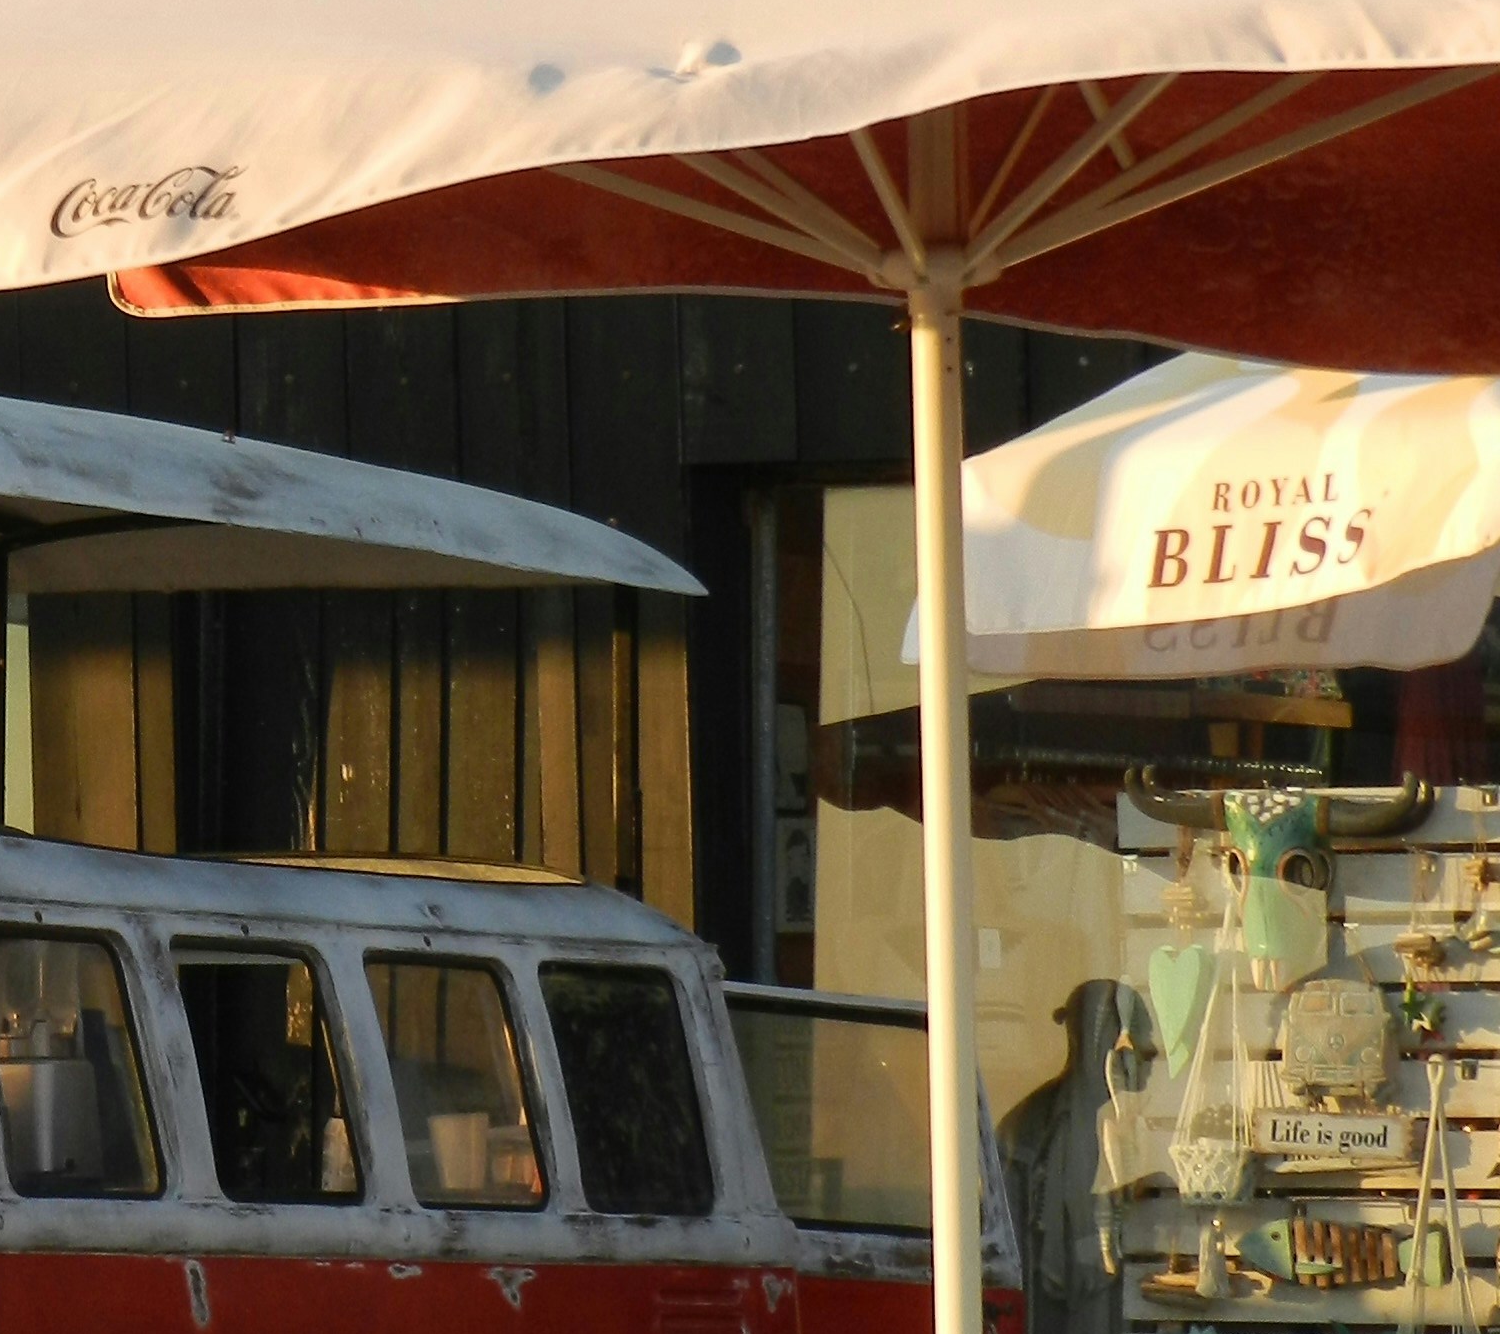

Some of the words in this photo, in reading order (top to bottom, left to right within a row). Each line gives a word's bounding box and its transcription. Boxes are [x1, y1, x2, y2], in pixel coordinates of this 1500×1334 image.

[1212, 473, 1339, 512] ROYAL
[1147, 508, 1374, 589] BLISS
[1270, 1119, 1311, 1145] Life
[1317, 1122, 1333, 1145] is
[1339, 1125, 1388, 1155] good
